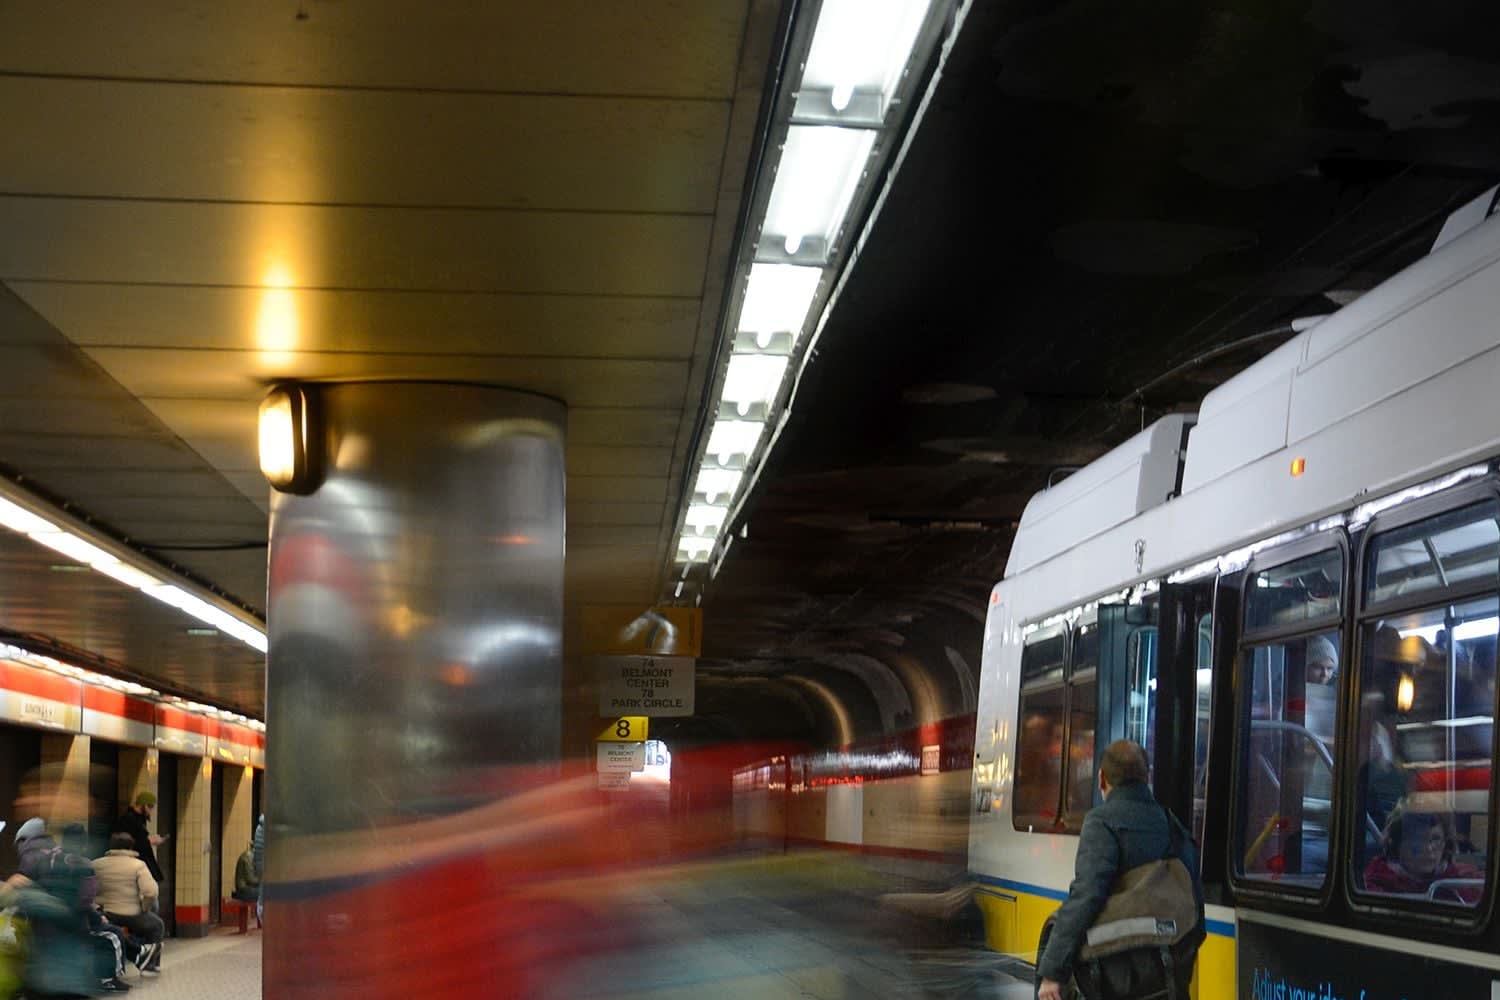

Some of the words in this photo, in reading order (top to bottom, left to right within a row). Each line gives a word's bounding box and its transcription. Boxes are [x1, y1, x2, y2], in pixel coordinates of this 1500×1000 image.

[621, 668, 673, 678] BELMONT
[626, 678, 669, 688] CENTER
[611, 699, 640, 708] PARK
[643, 699, 683, 708] CIRCLE
[616, 719, 631, 738] 8
